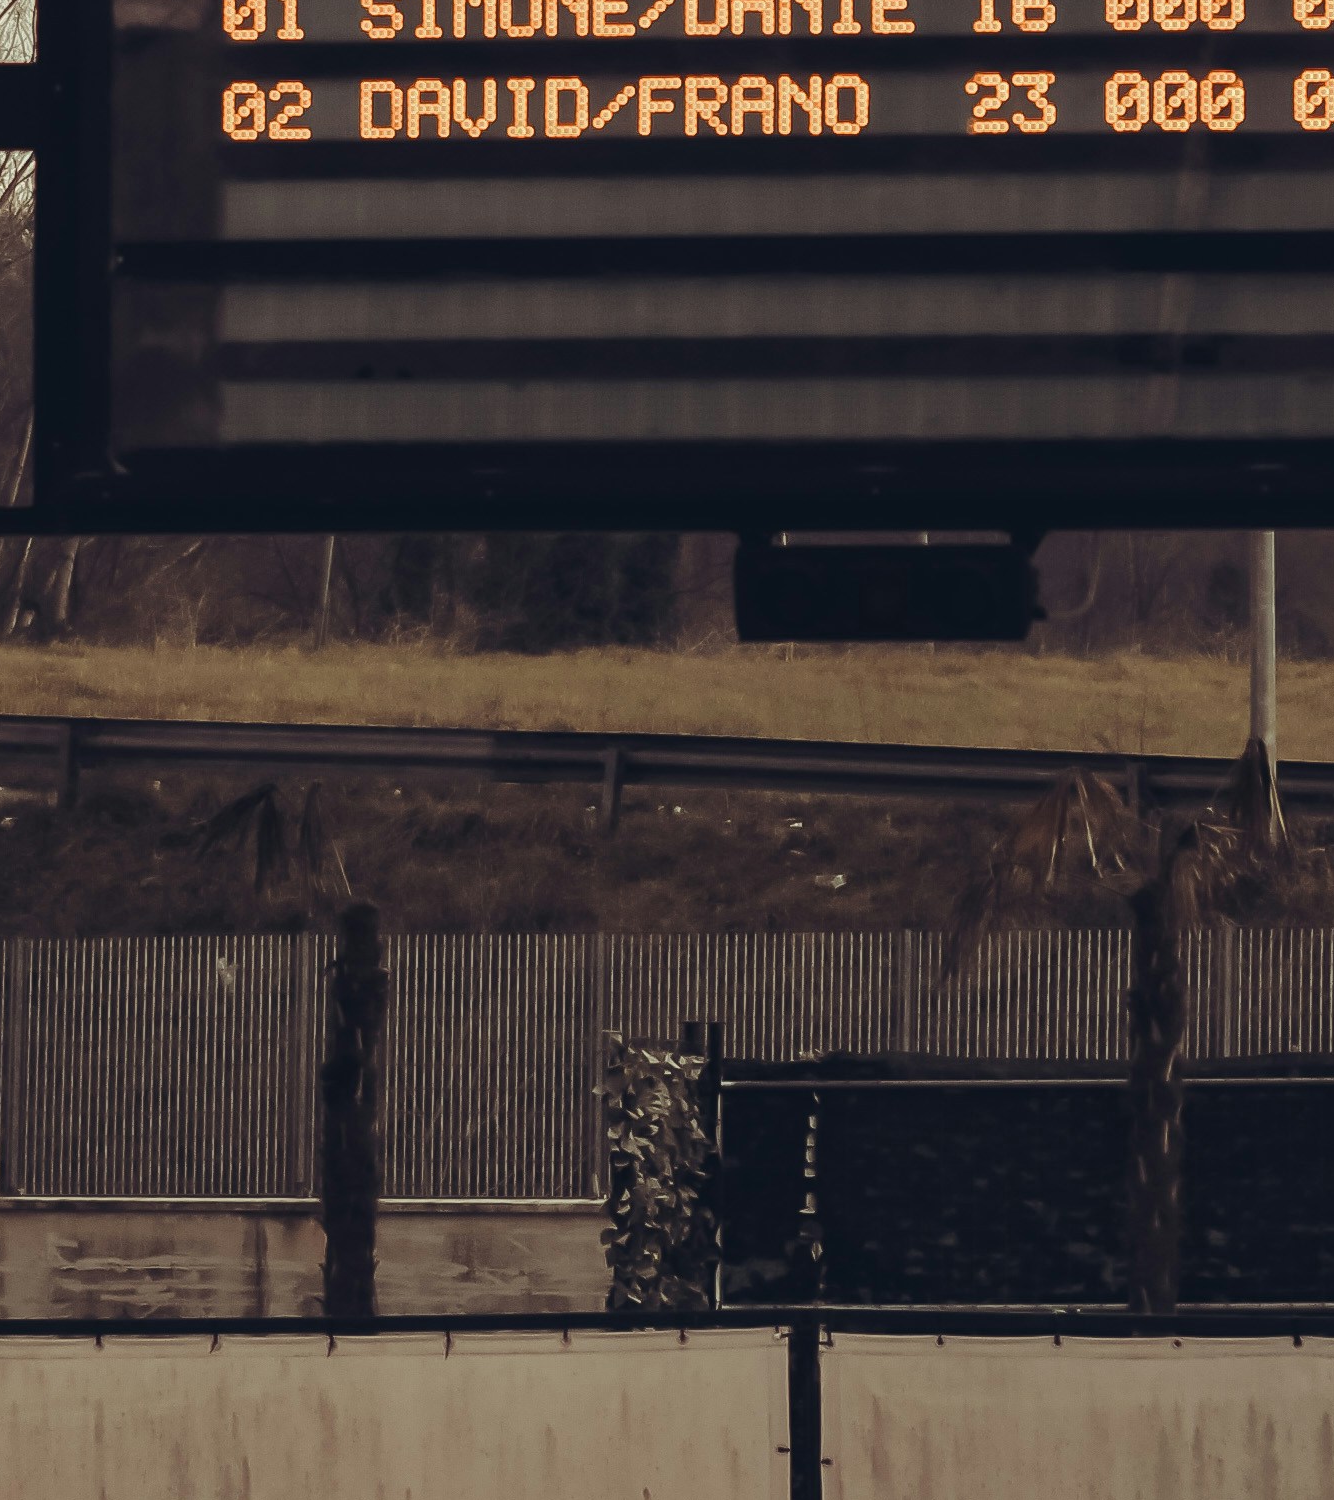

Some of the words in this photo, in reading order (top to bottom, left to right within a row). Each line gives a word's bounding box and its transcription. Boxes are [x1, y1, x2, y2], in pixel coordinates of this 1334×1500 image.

[223, 82, 312, 141] 02
[360, 74, 870, 139] DAVID/FRANO
[965, 72, 1057, 135] 23
[1105, 70, 1246, 132] 000
